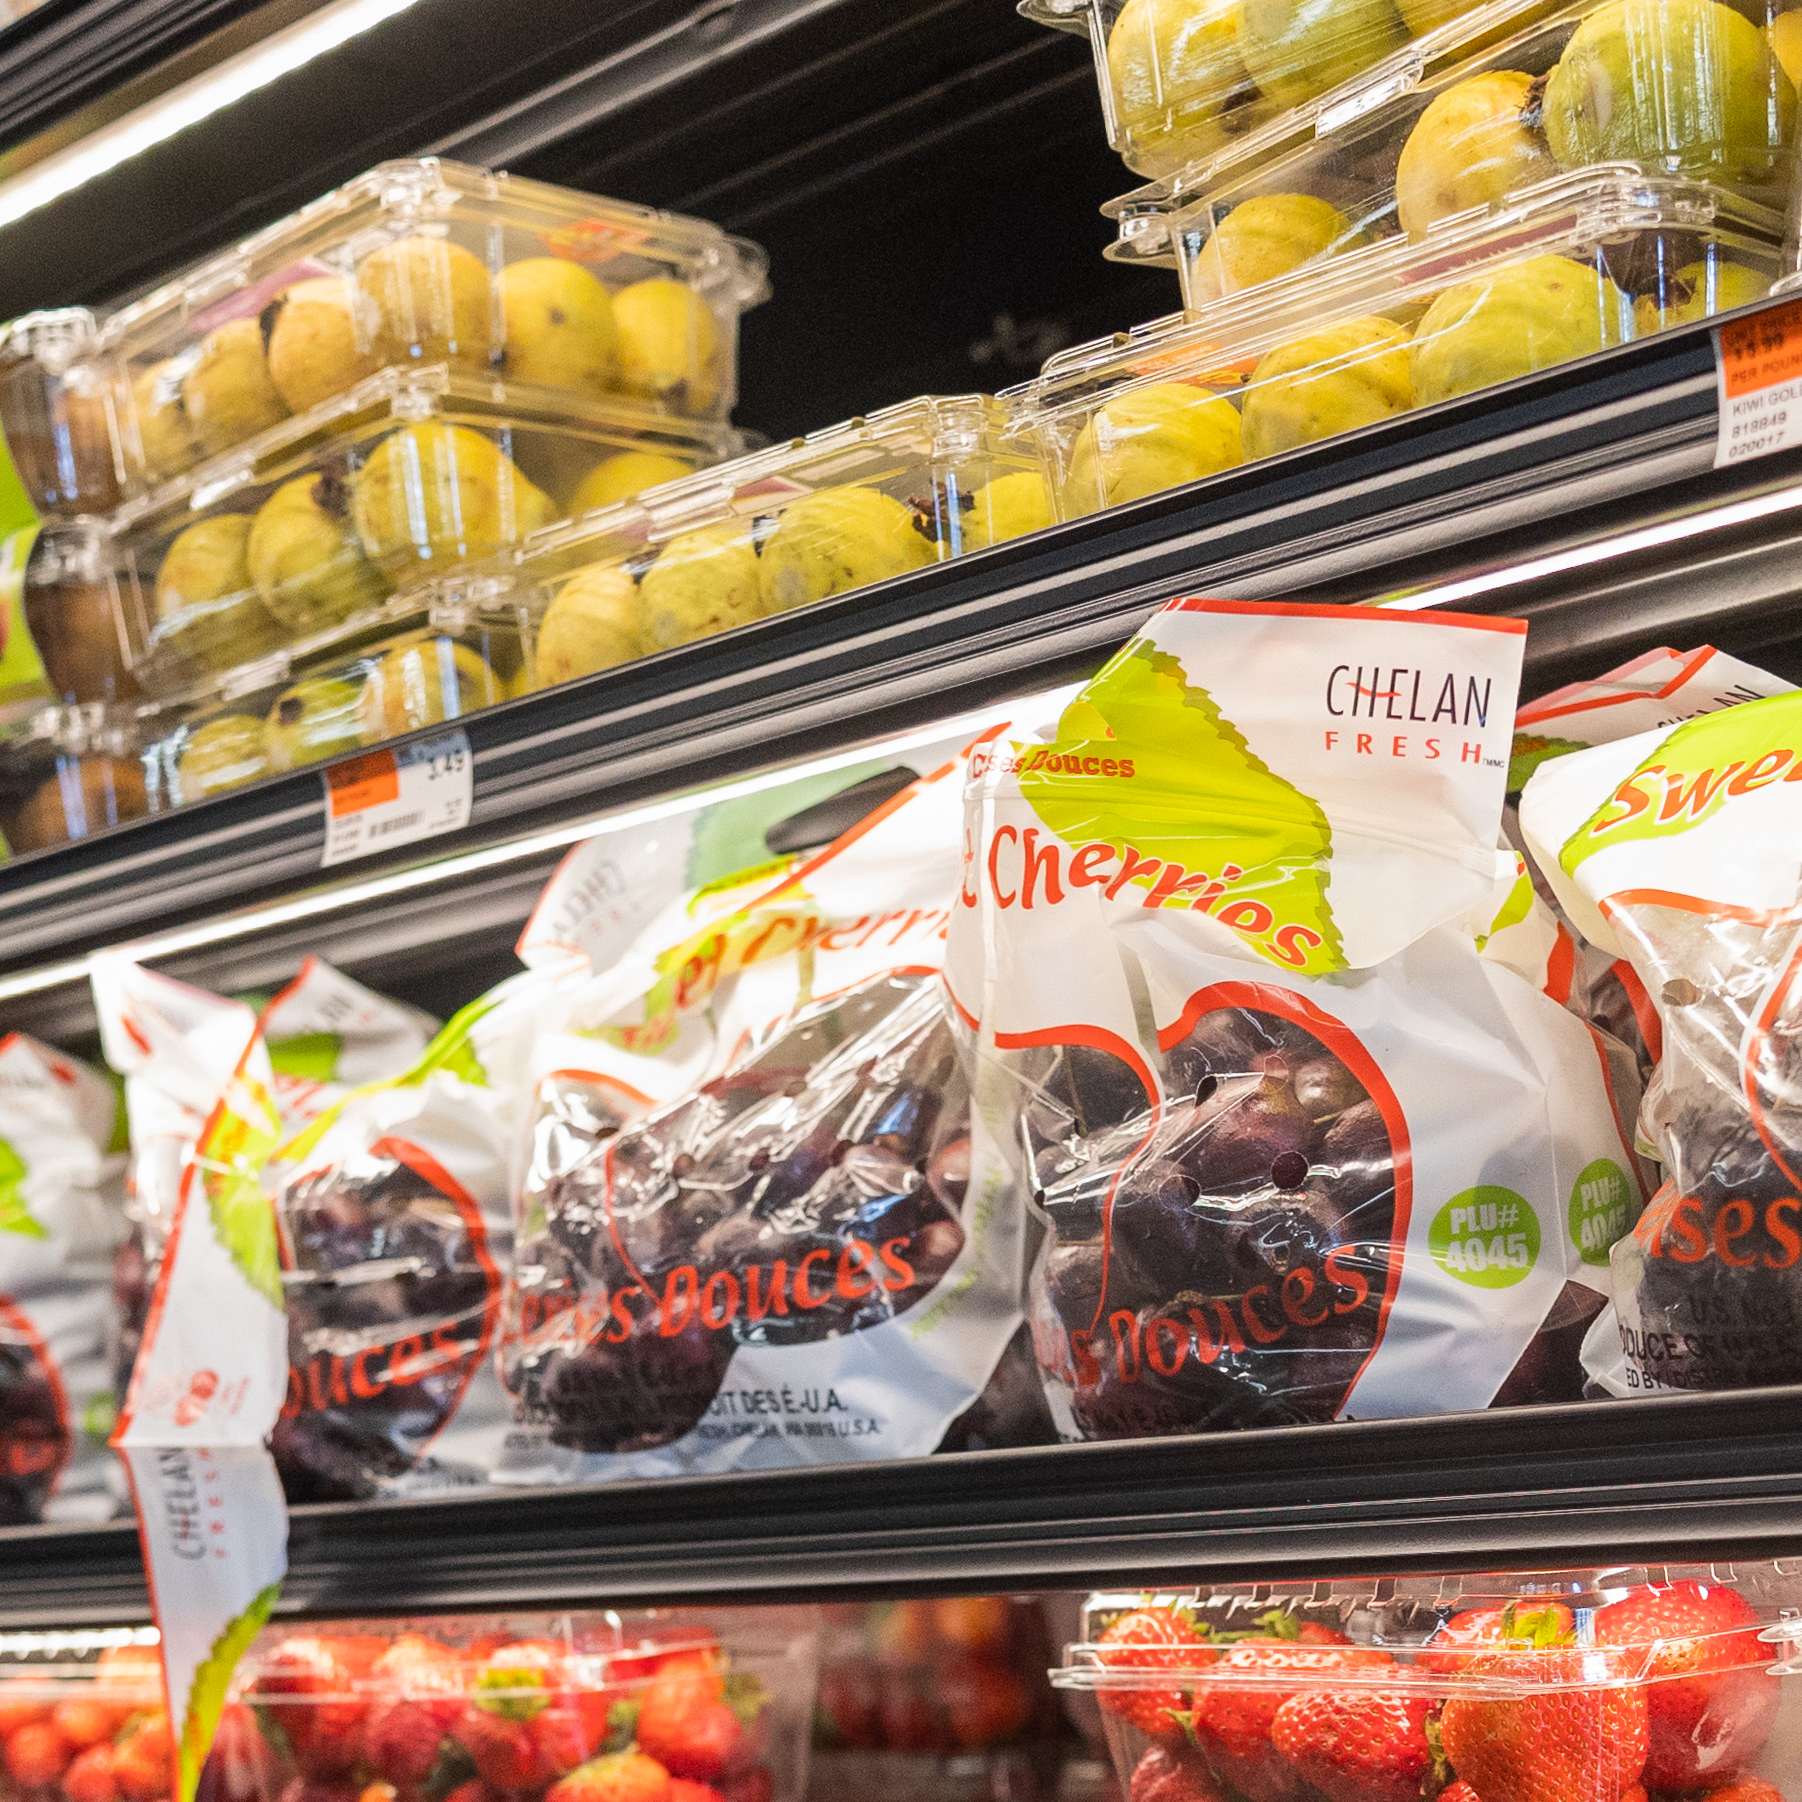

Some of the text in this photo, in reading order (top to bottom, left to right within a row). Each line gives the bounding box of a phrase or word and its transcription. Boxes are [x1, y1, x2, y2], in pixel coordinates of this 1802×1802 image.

[1731, 397, 1765, 419] KIWI
[1326, 664, 1492, 729] CHELAN
[1024, 749, 1136, 779] Douces
[1324, 730, 1482, 765] FRESH
[987, 823, 1323, 968] Cherries
[1580, 1175, 1623, 1212] PLU#
[1450, 1203, 1520, 1235] PLU#
[1580, 1204, 1627, 1252] 4045
[1445, 1232, 1529, 1274] 4045
[659, 1236, 917, 1339] Douces
[1108, 1244, 1369, 1384] Douces
[739, 1387, 782, 1415] DES
